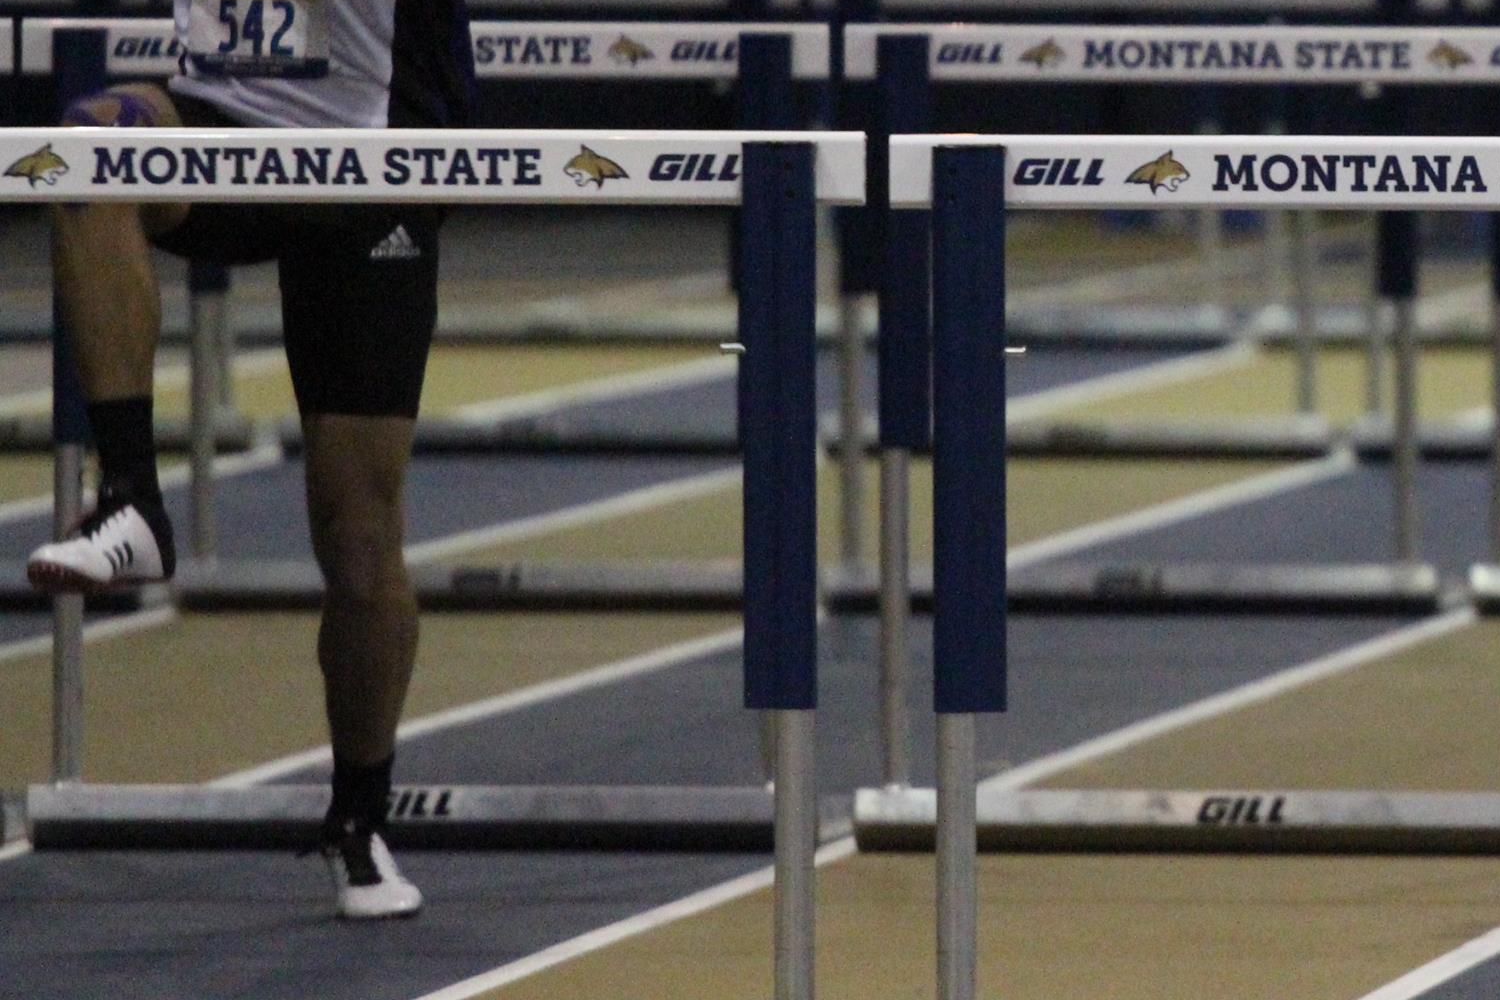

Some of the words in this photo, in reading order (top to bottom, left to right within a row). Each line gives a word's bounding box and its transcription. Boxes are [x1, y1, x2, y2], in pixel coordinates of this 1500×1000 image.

[475, 36, 592, 65] STATE
[936, 43, 1004, 64] GILL
[1083, 40, 1283, 69] MONTANA
[1295, 41, 1410, 70] STATE
[91, 146, 367, 185] MONTANA
[383, 147, 542, 186] STATE
[648, 153, 741, 181] GILL
[1012, 158, 1105, 186] GILL
[1211, 154, 1488, 193] MONTANA
[1197, 796, 1286, 823] GILL
